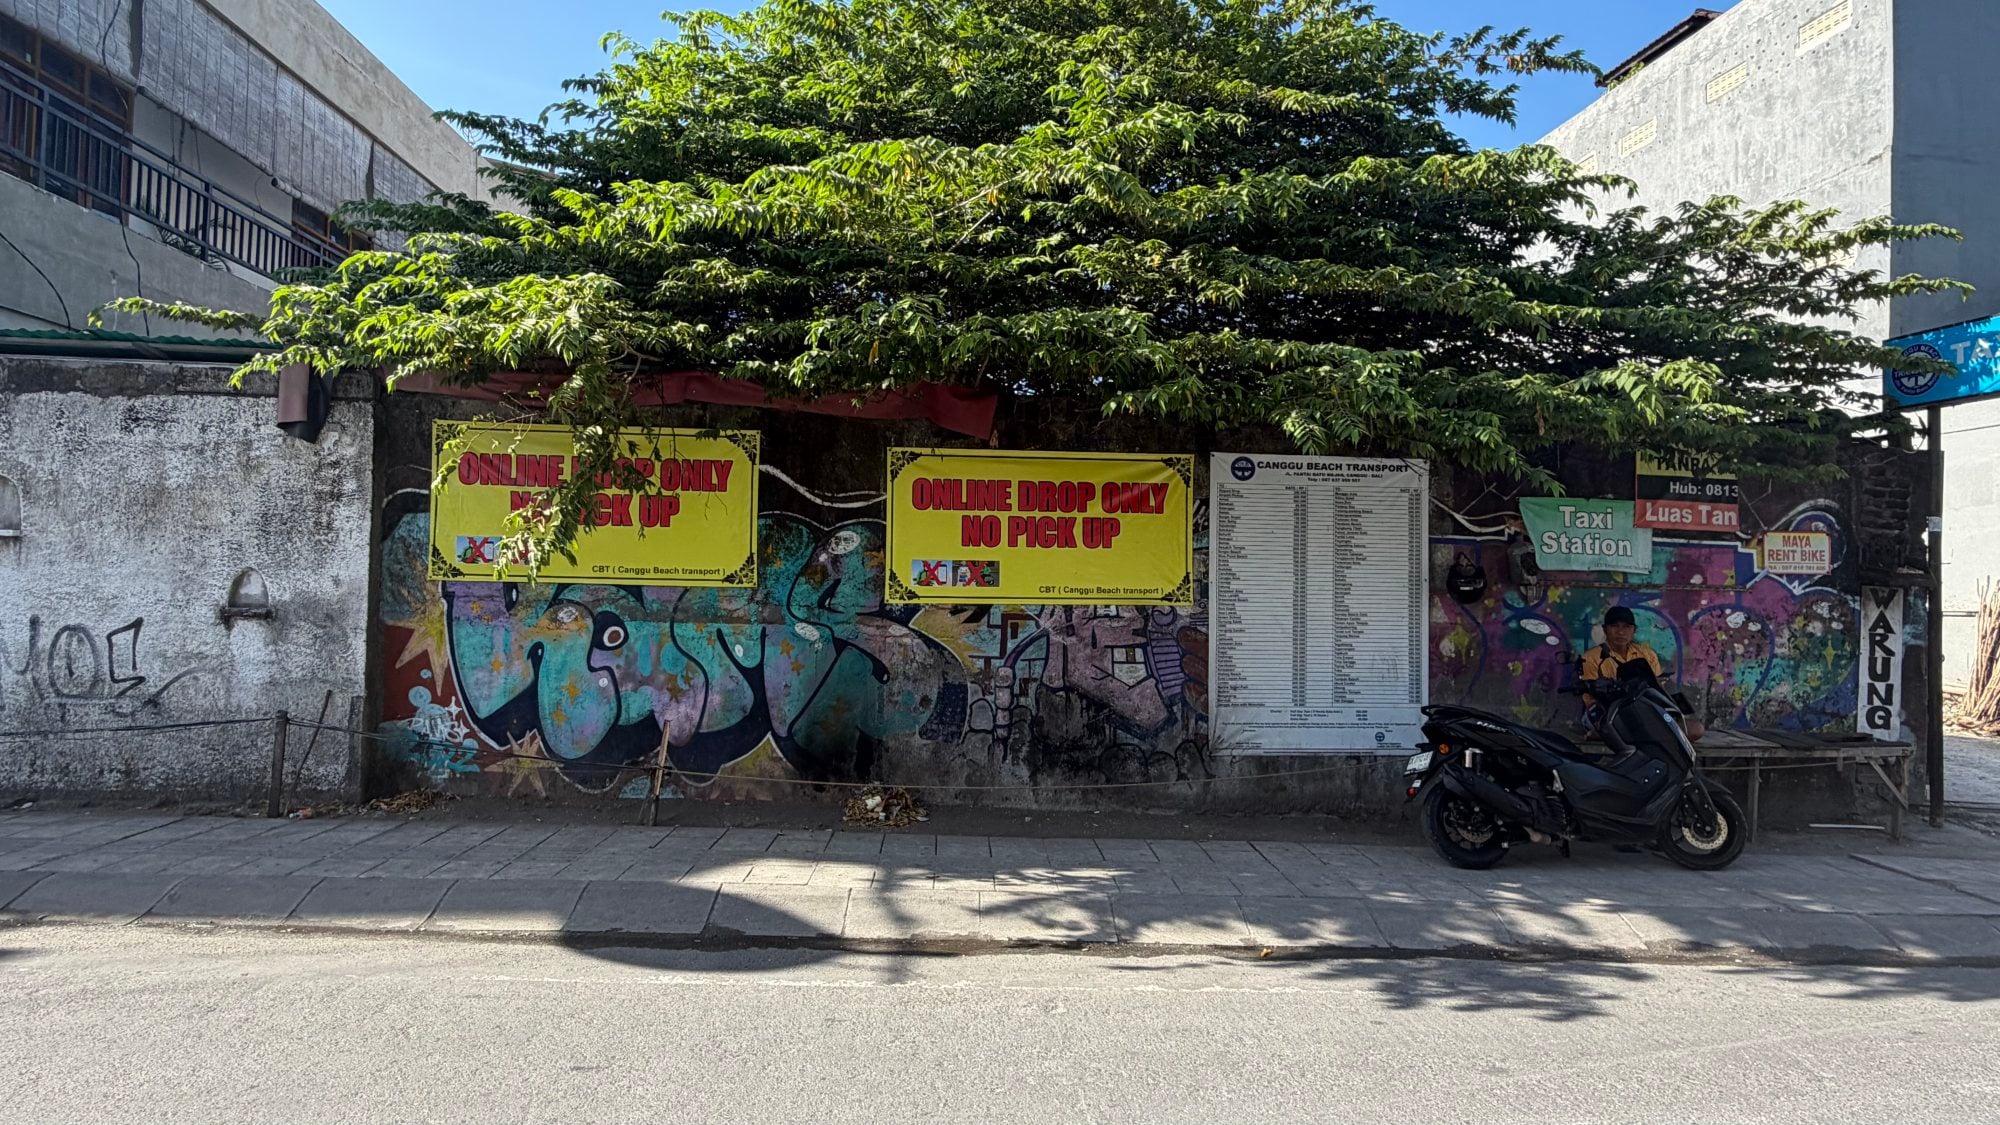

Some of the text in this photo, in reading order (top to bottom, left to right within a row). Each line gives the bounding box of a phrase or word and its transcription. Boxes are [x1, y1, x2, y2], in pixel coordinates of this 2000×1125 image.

[1950, 334, 2000, 365] TA
[458, 452, 566, 487] ONLINE
[660, 459, 733, 492] ONLY
[1257, 461, 1409, 473] CANGGU BEACH TRANSPORT
[912, 478, 1169, 514] ONLINE DROP ONLY
[1669, 481, 1739, 497] Hub: 0813
[638, 495, 680, 527] UP
[1558, 505, 1613, 529] Taxi
[1645, 501, 1737, 525] Luas Tan
[962, 515, 1120, 549] NO PICK UP
[1541, 531, 1632, 557] Station
[1782, 535, 1812, 548] MAYA
[1768, 549, 1825, 562] RENT BIKE
[592, 565, 610, 573] CBT
[618, 566, 651, 576] Canggu
[653, 567, 679, 575] Beach
[682, 567, 721, 577] transport
[1039, 586, 1056, 594] CBT
[1063, 586, 1094, 595] Canggu
[1123, 587, 1159, 596] transport
[1865, 588, 1899, 730] WARUNG
